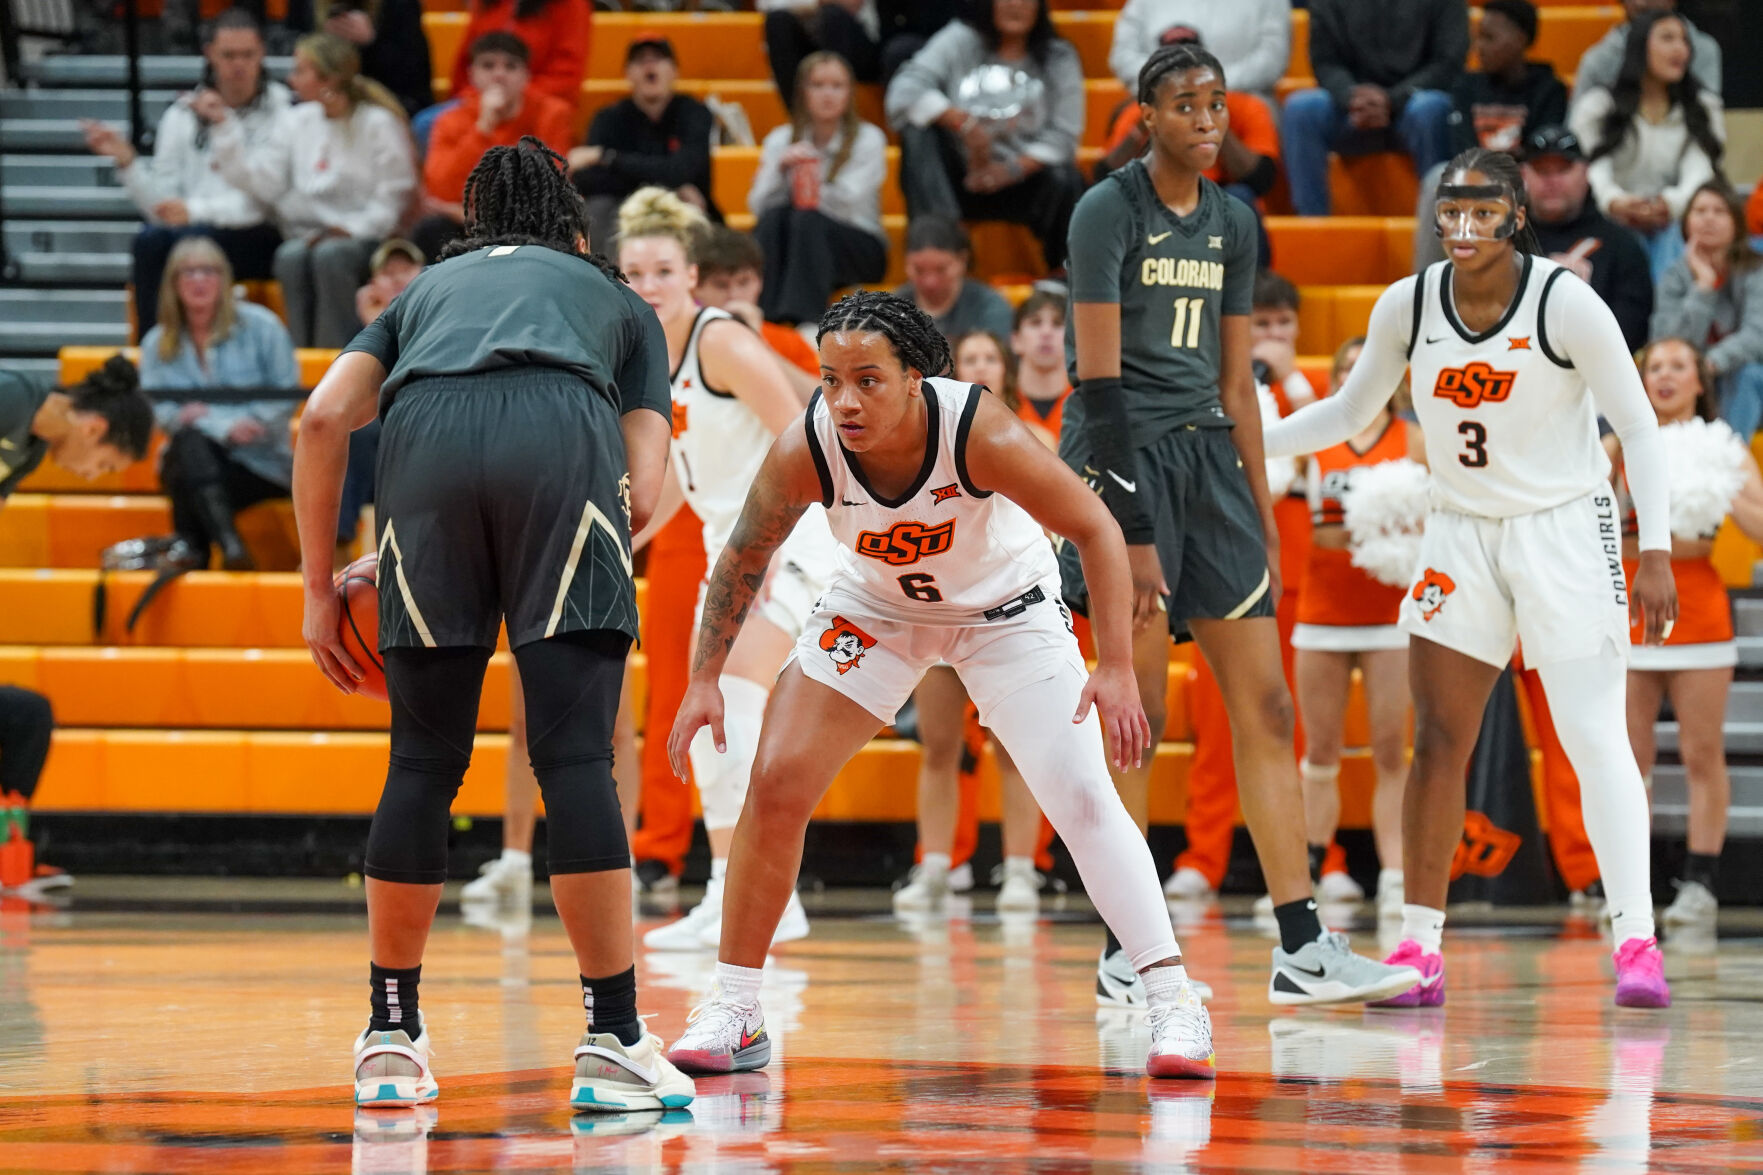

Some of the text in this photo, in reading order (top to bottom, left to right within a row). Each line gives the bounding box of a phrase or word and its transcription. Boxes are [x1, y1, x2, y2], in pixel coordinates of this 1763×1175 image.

[1171, 297, 1204, 348] 11
[1433, 361, 1519, 409] OSU
[1457, 420, 1488, 468] 3
[855, 517, 956, 567] OSU
[1594, 496, 1628, 605] COWGIRLS
[896, 572, 943, 602] 6
[1450, 809, 1523, 881] SU
